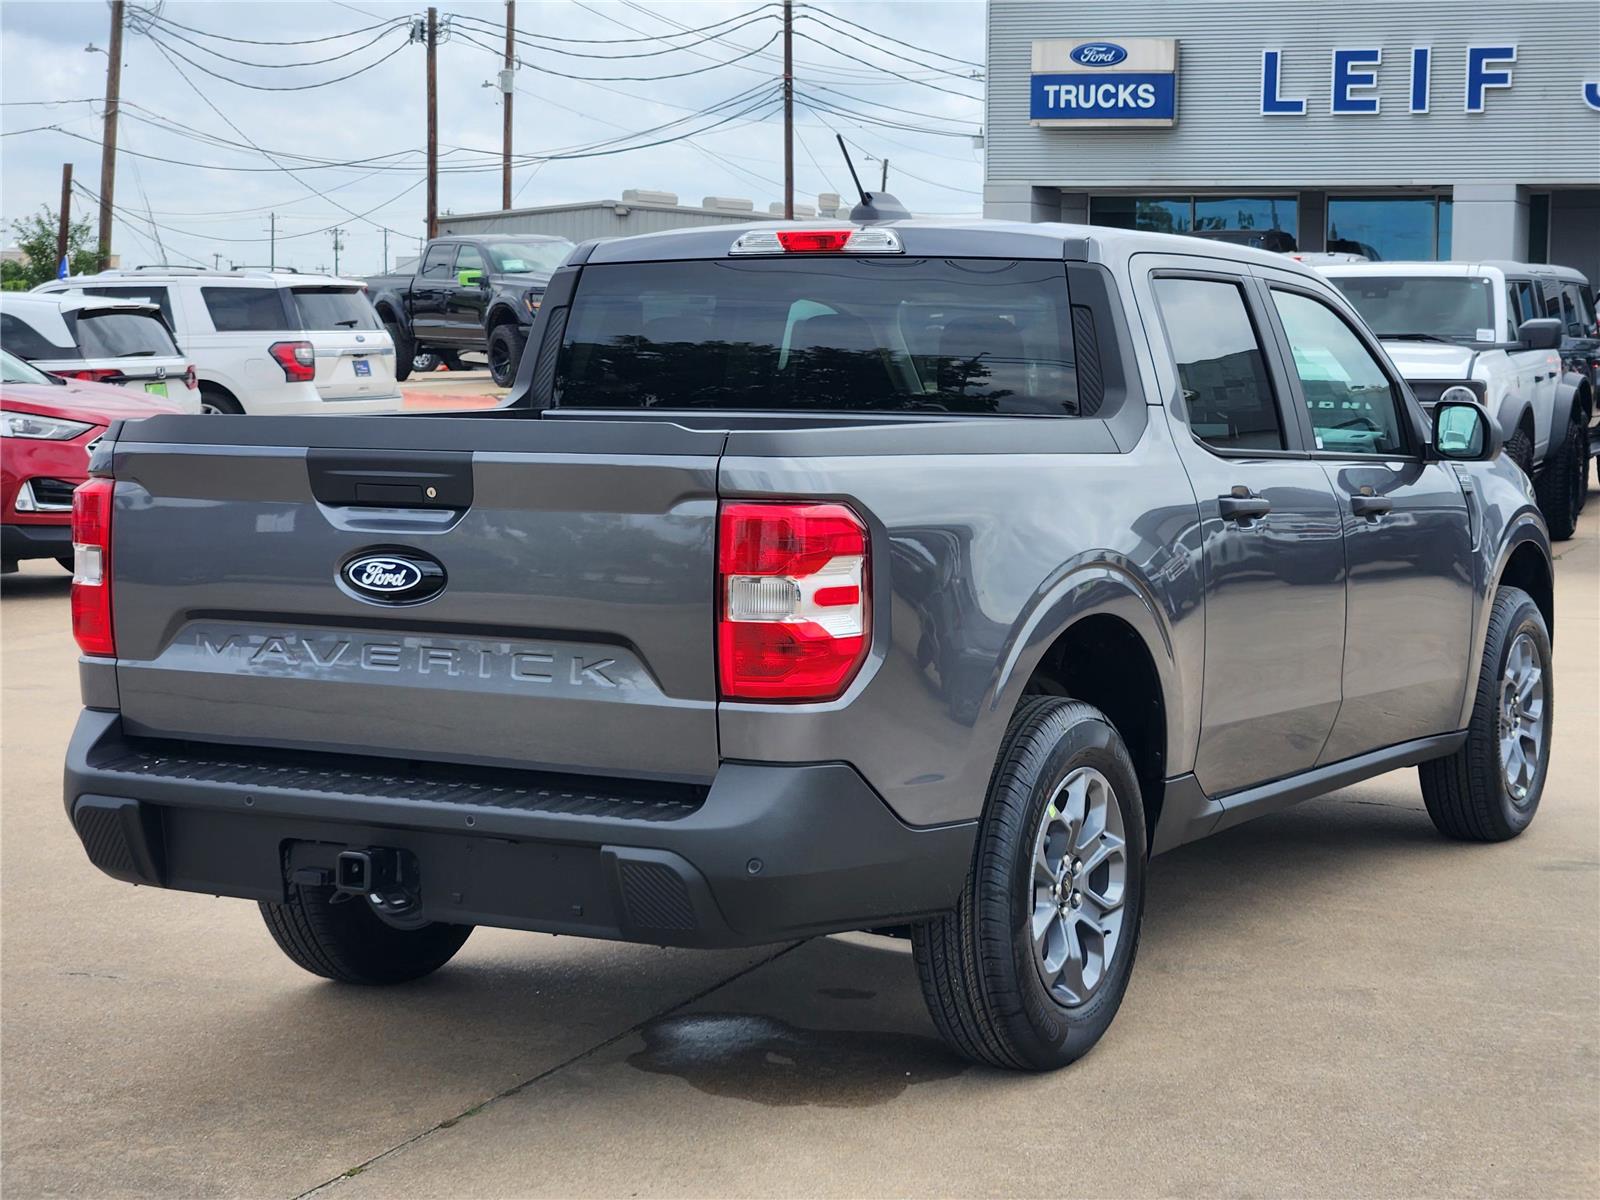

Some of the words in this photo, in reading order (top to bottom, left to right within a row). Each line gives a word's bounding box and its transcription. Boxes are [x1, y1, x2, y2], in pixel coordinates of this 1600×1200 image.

[1080, 46, 1116, 63] Ford
[1260, 44, 1518, 116] LEIF
[1043, 83, 1156, 108] TRUCKS
[361, 562, 407, 586] Ford
[195, 632, 617, 688] MAVERICK
